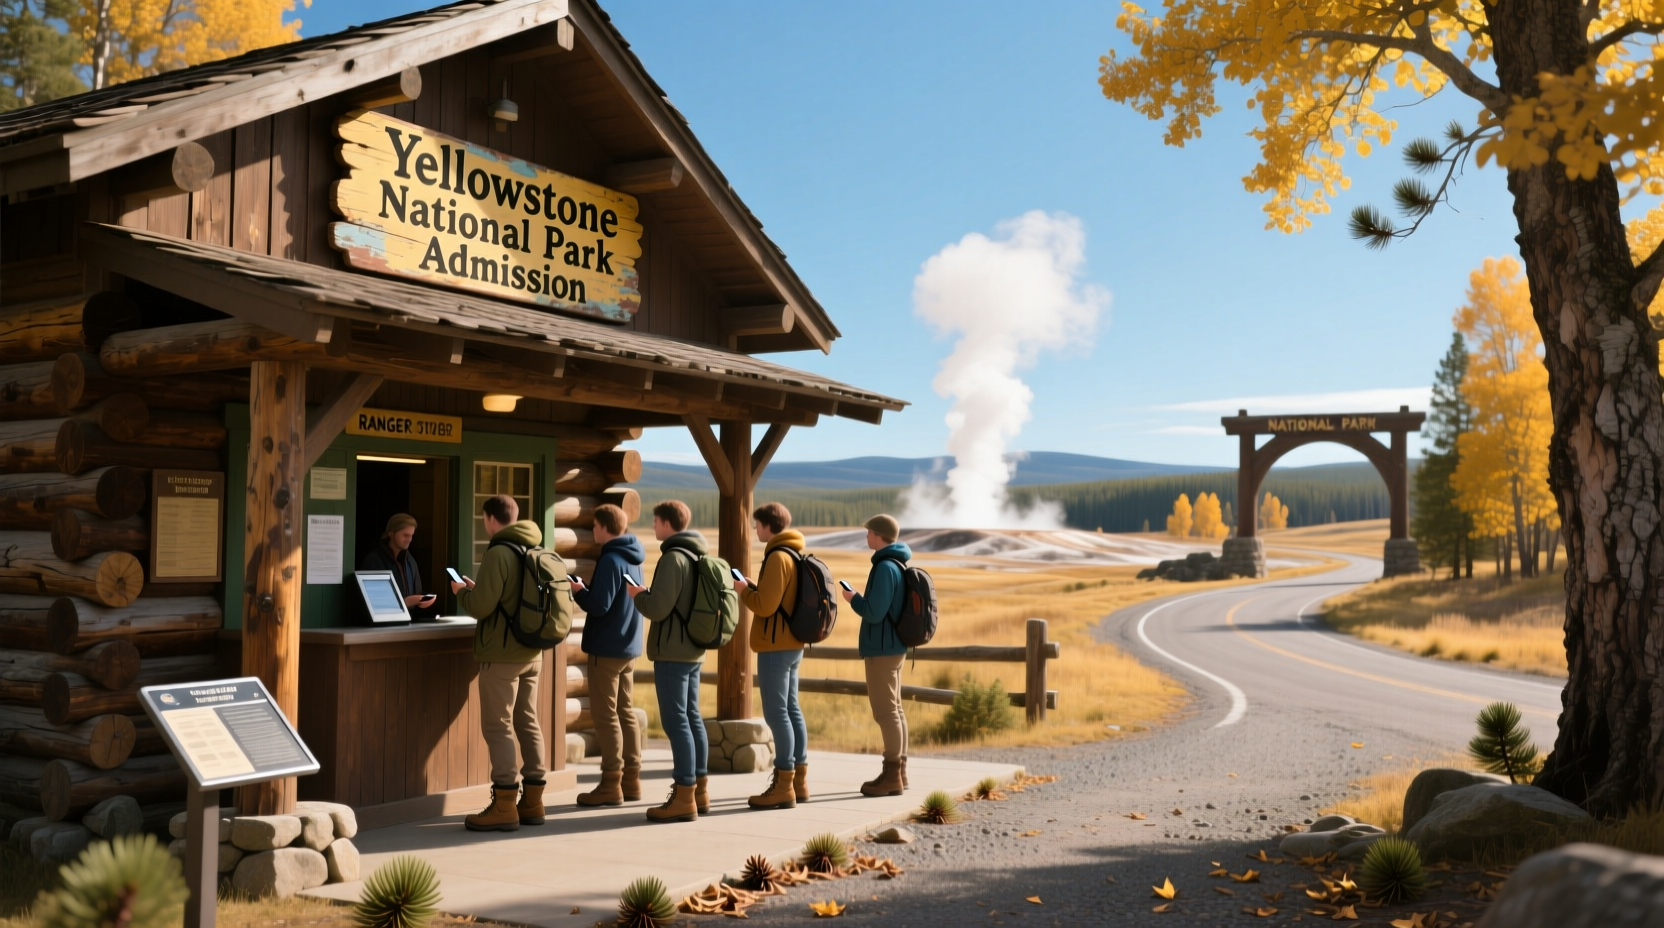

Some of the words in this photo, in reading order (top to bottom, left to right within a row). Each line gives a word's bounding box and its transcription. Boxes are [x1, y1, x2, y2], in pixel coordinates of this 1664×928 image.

[385, 126, 619, 238] Yellowstone
[378, 179, 531, 254] National
[543, 225, 615, 275] Park
[418, 236, 587, 304] Admission
[358, 414, 412, 434] RANGER
[1267, 417, 1335, 432] NATIONAL
[1342, 416, 1376, 430] PARK
